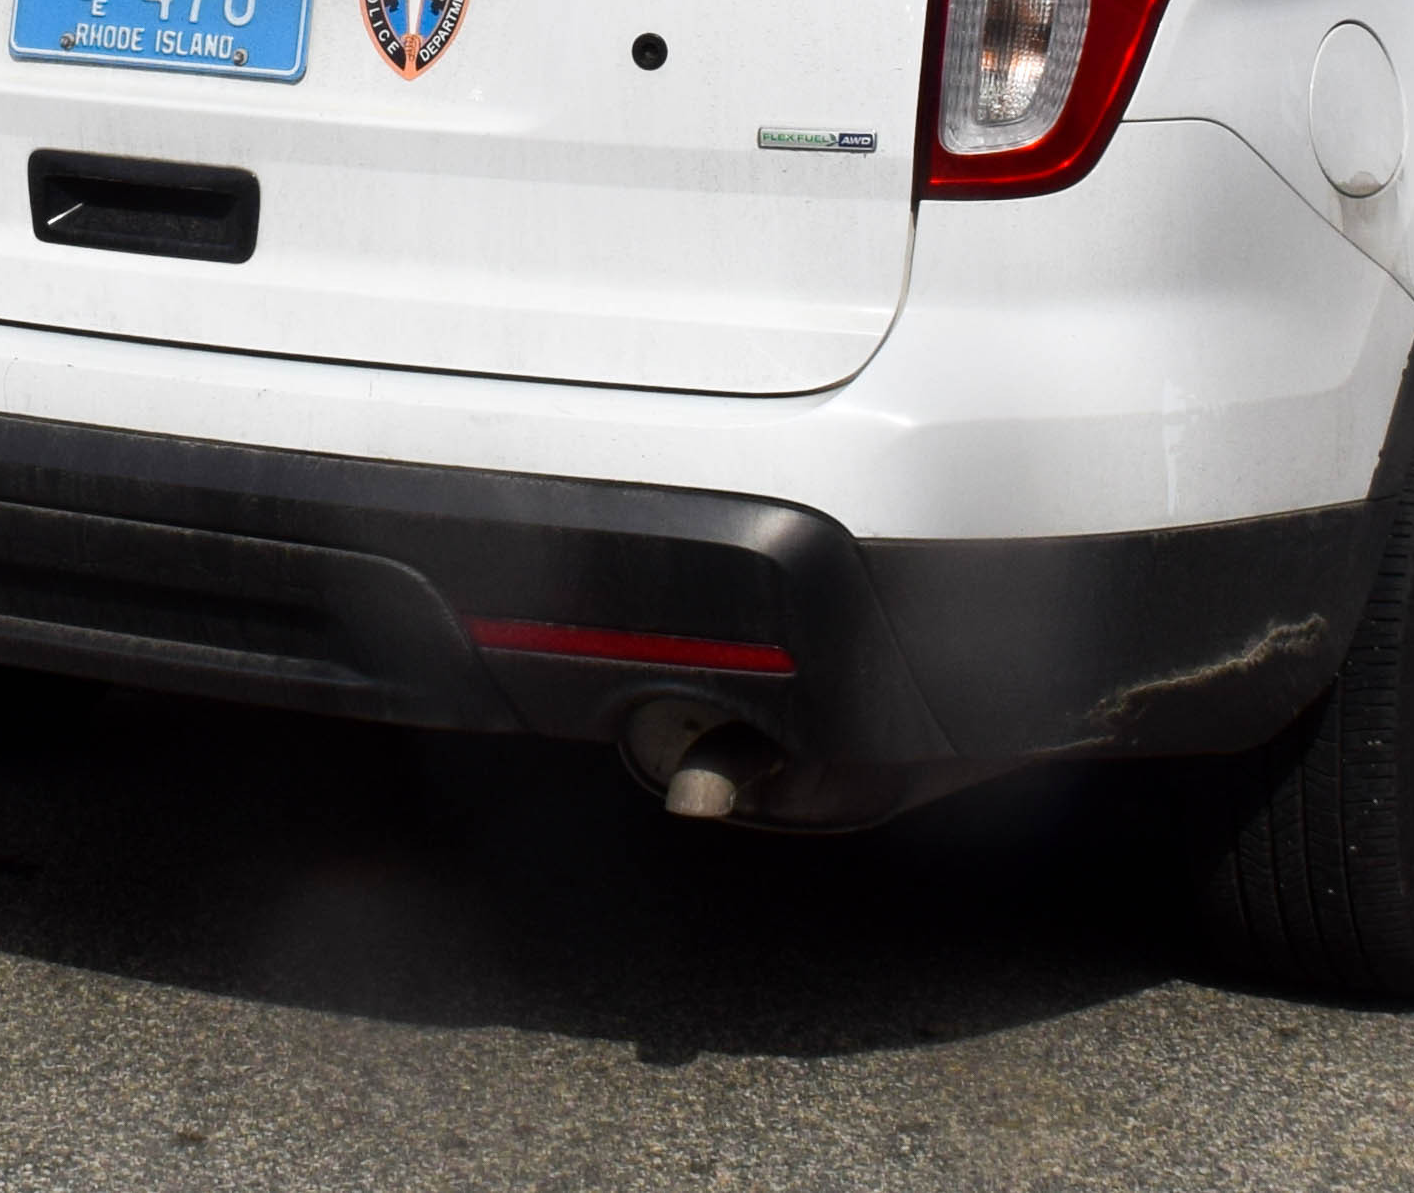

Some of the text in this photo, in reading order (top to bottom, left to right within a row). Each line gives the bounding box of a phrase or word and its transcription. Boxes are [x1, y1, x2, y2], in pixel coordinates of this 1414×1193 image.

[74, 22, 235, 59] RHODE ISLAND
[841, 136, 871, 146] AWD
